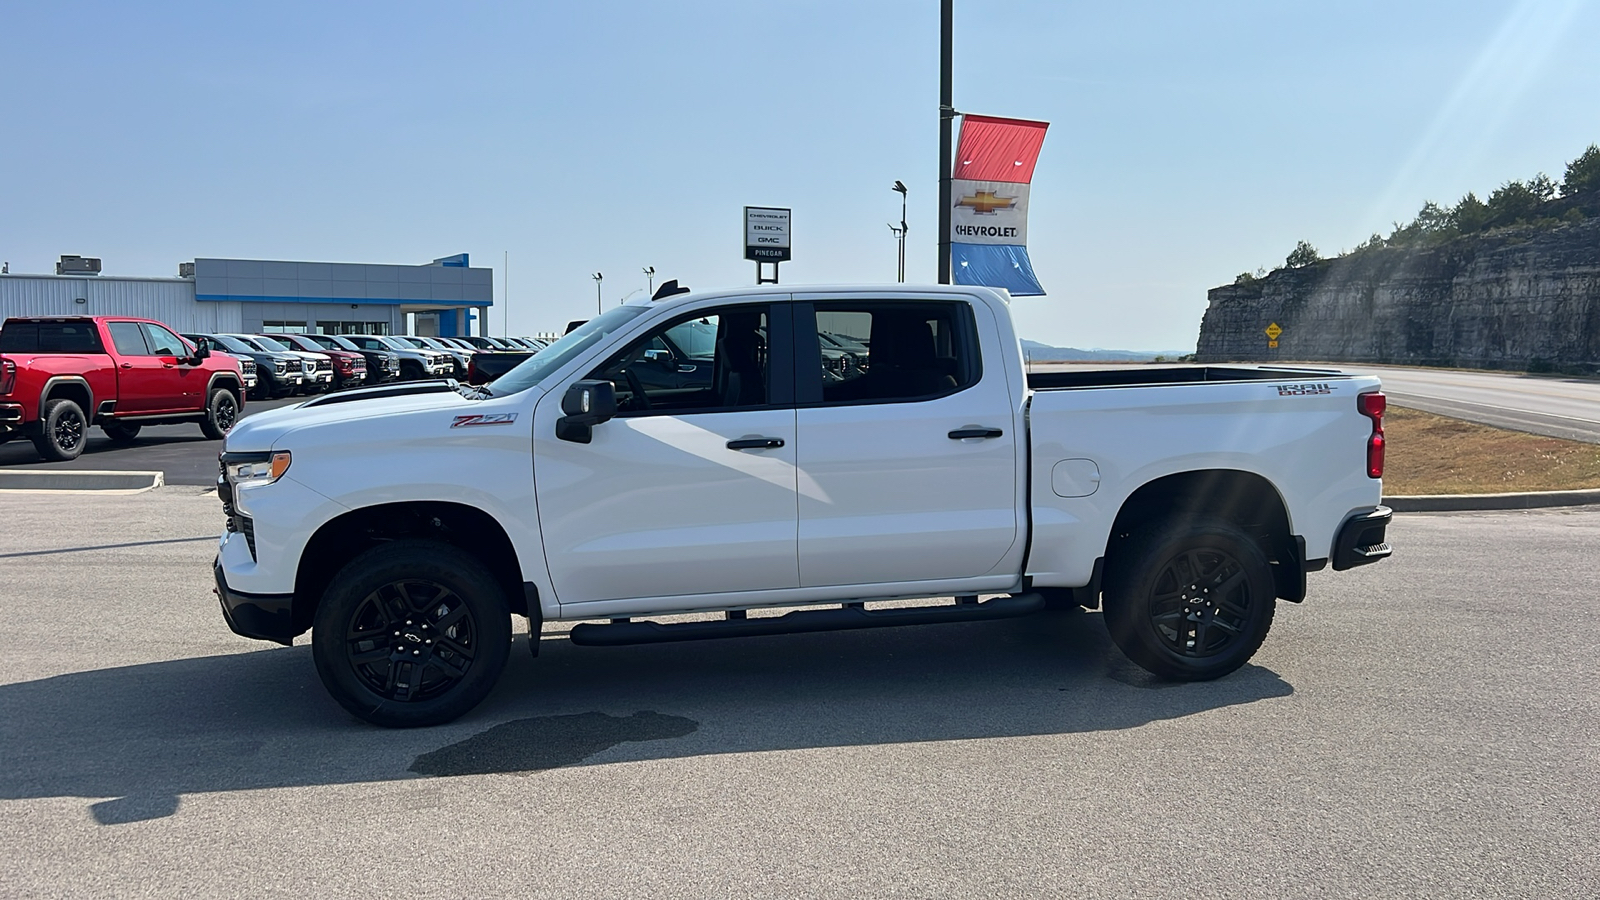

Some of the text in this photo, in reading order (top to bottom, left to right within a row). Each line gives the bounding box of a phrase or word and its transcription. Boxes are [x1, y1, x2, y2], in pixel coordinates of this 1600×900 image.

[955, 224, 1017, 237] CHEVROLET
[754, 249, 783, 257] PINEGAR
[1267, 383, 1338, 392] TRAIL
[450, 412, 519, 429] Z71
